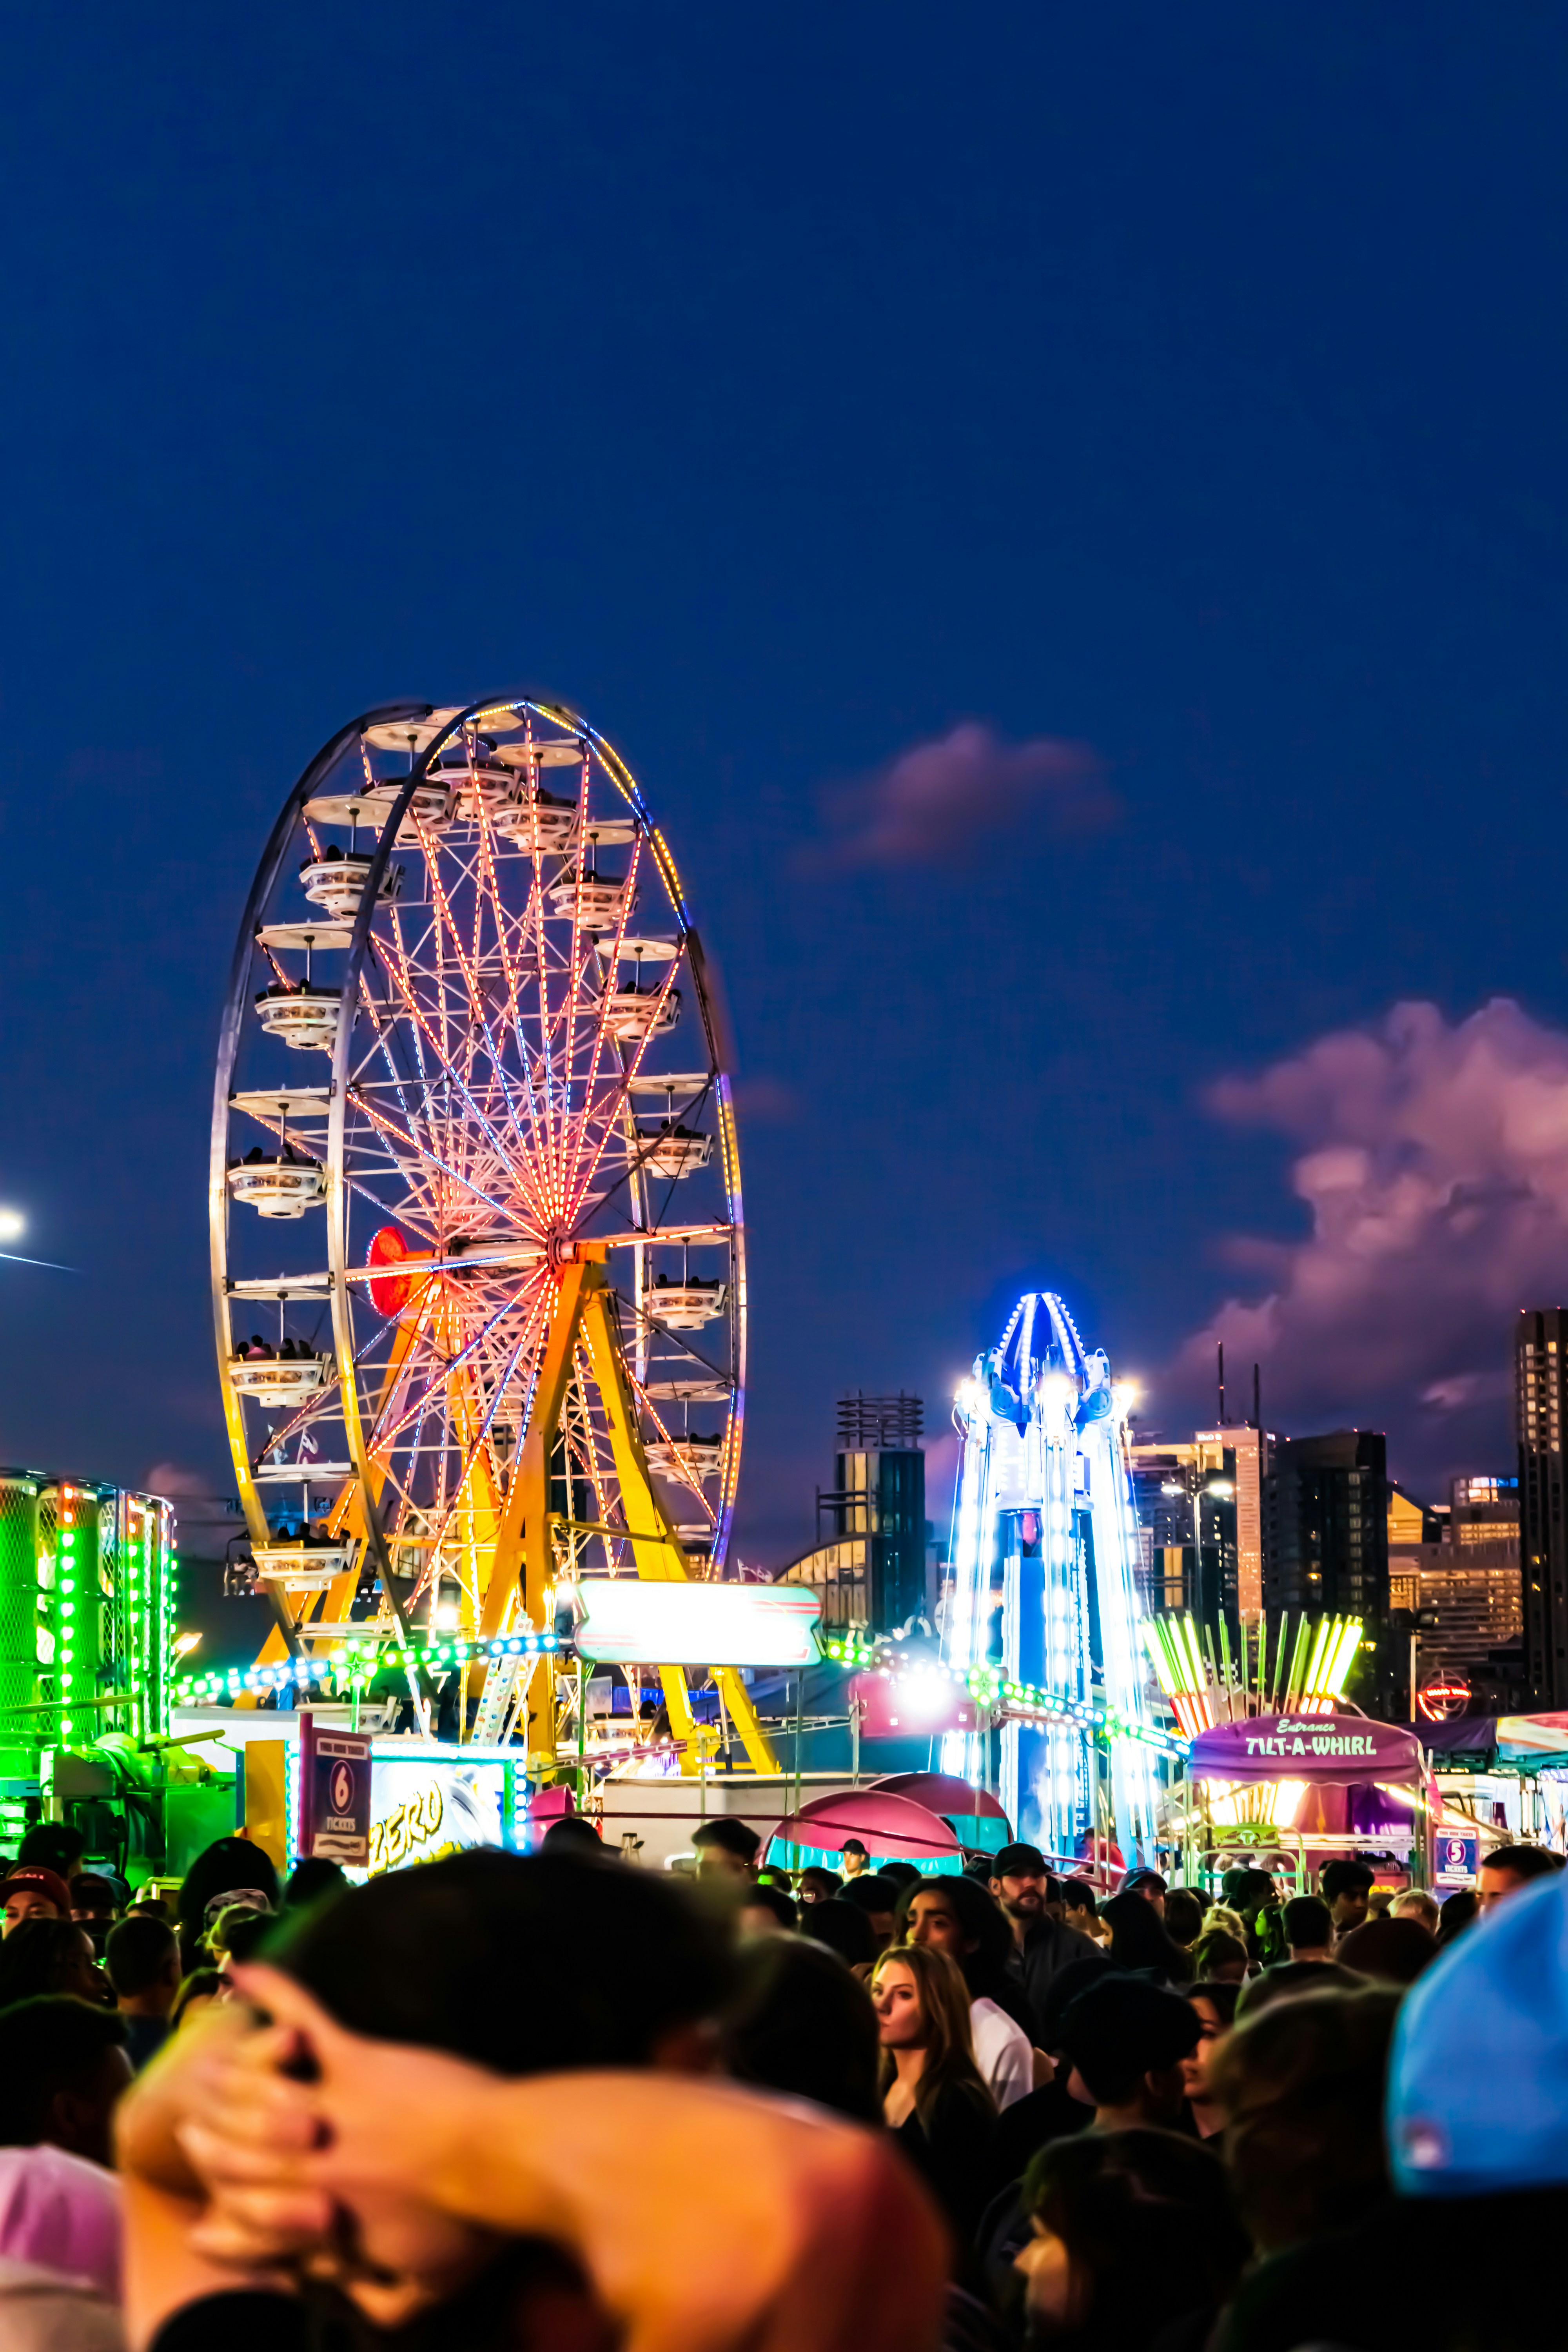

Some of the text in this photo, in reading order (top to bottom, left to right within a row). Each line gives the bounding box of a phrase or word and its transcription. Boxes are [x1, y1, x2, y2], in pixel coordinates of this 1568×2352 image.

[1276, 1719, 1336, 1733] Entrance
[1246, 1736, 1377, 1755] TILT-A-WHIRL
[335, 1765, 349, 1808] 6
[327, 1816, 356, 1832] TICKETS
[367, 1780, 443, 1879] ZERO
[1451, 1842, 1461, 1862] 5
